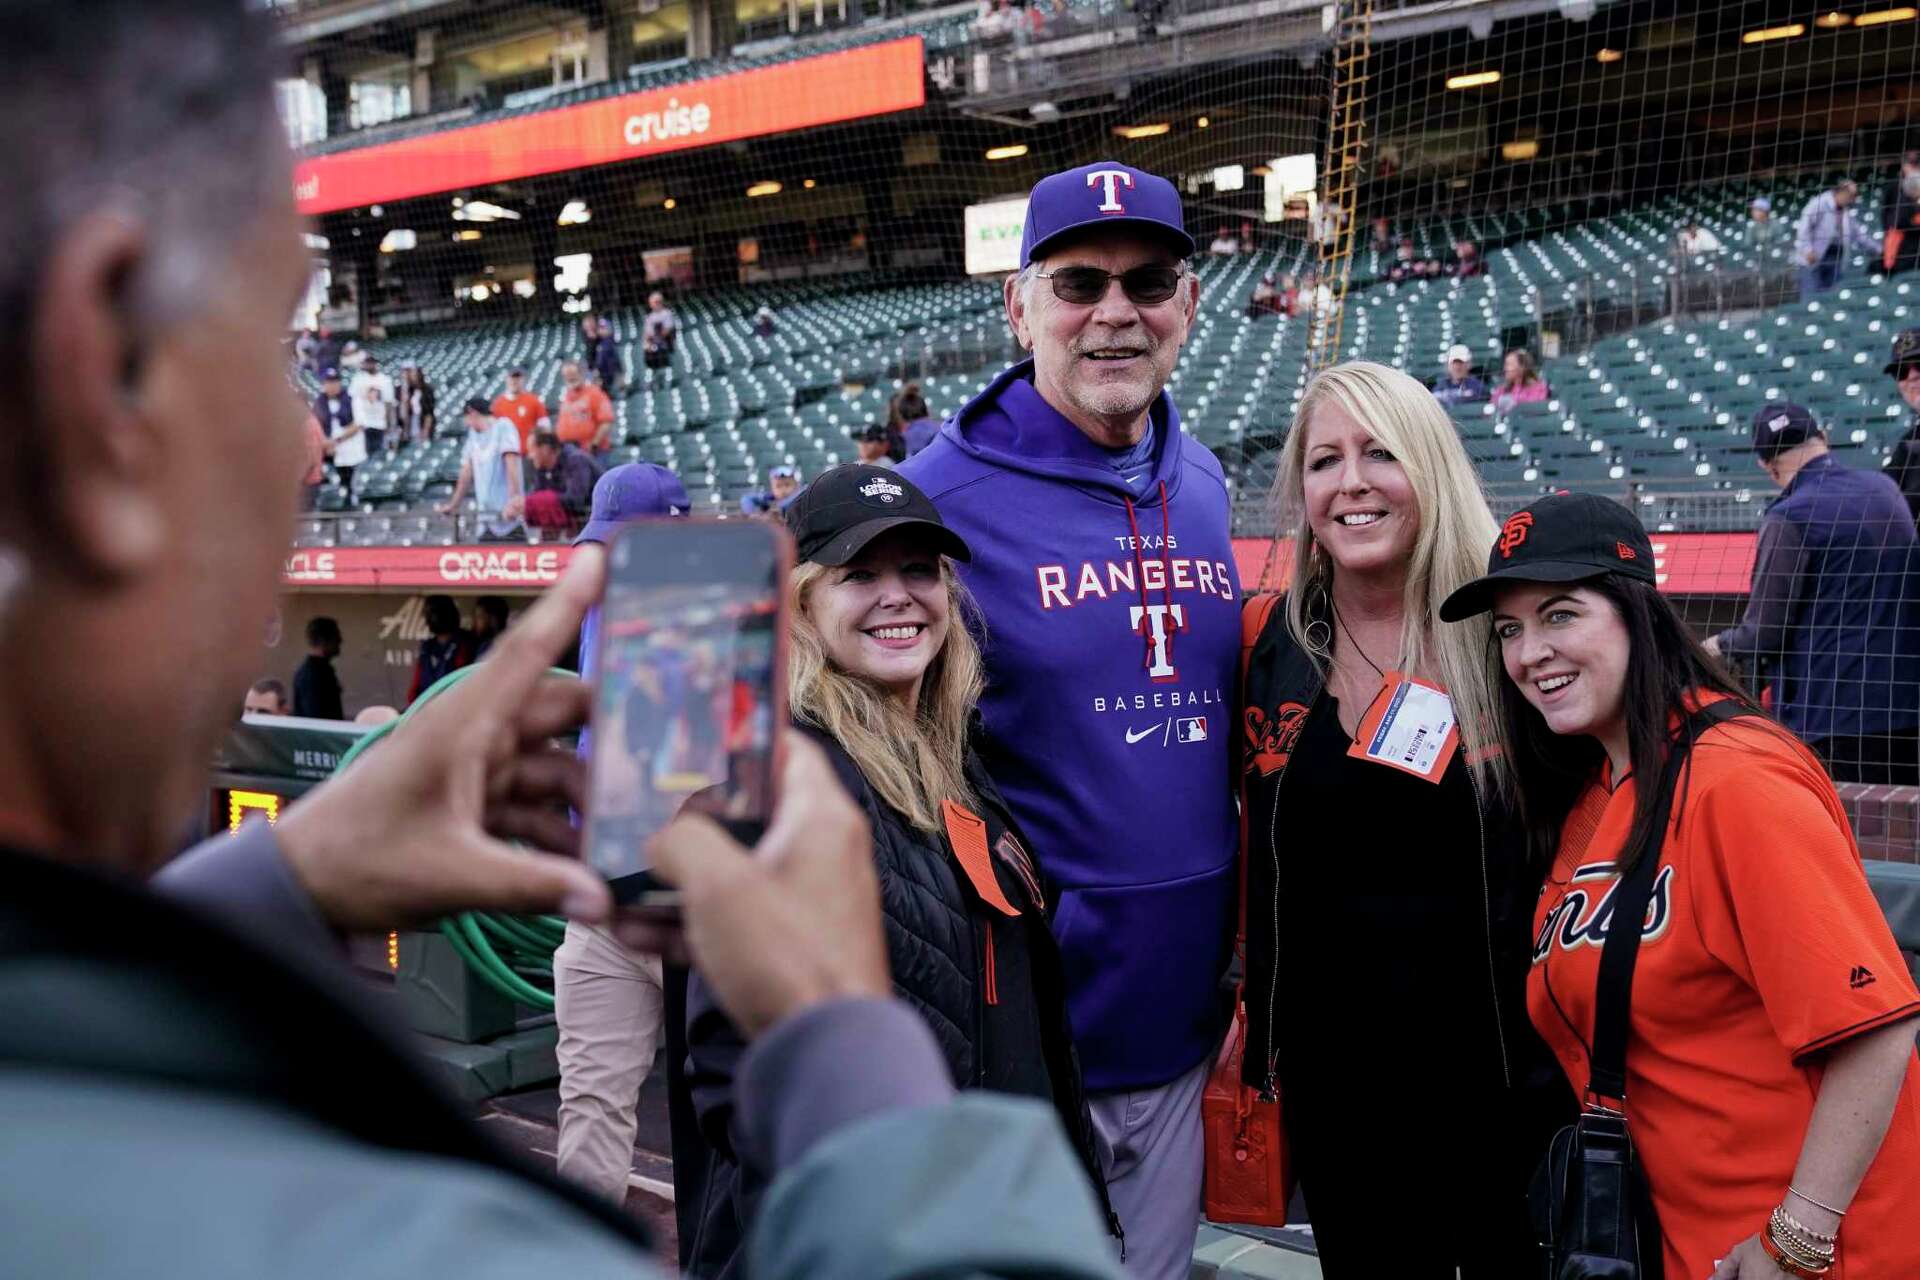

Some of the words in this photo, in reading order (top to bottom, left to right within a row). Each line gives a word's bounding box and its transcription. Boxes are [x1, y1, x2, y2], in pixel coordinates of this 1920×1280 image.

[624, 97, 711, 145] cruise
[1087, 170, 1134, 215] T
[1114, 535, 1177, 550] TEXAS
[439, 552, 558, 581] ORACLE
[1037, 560, 1234, 609] RANGERS
[1129, 604, 1188, 682] T
[1094, 689, 1222, 712] BASEBALL
